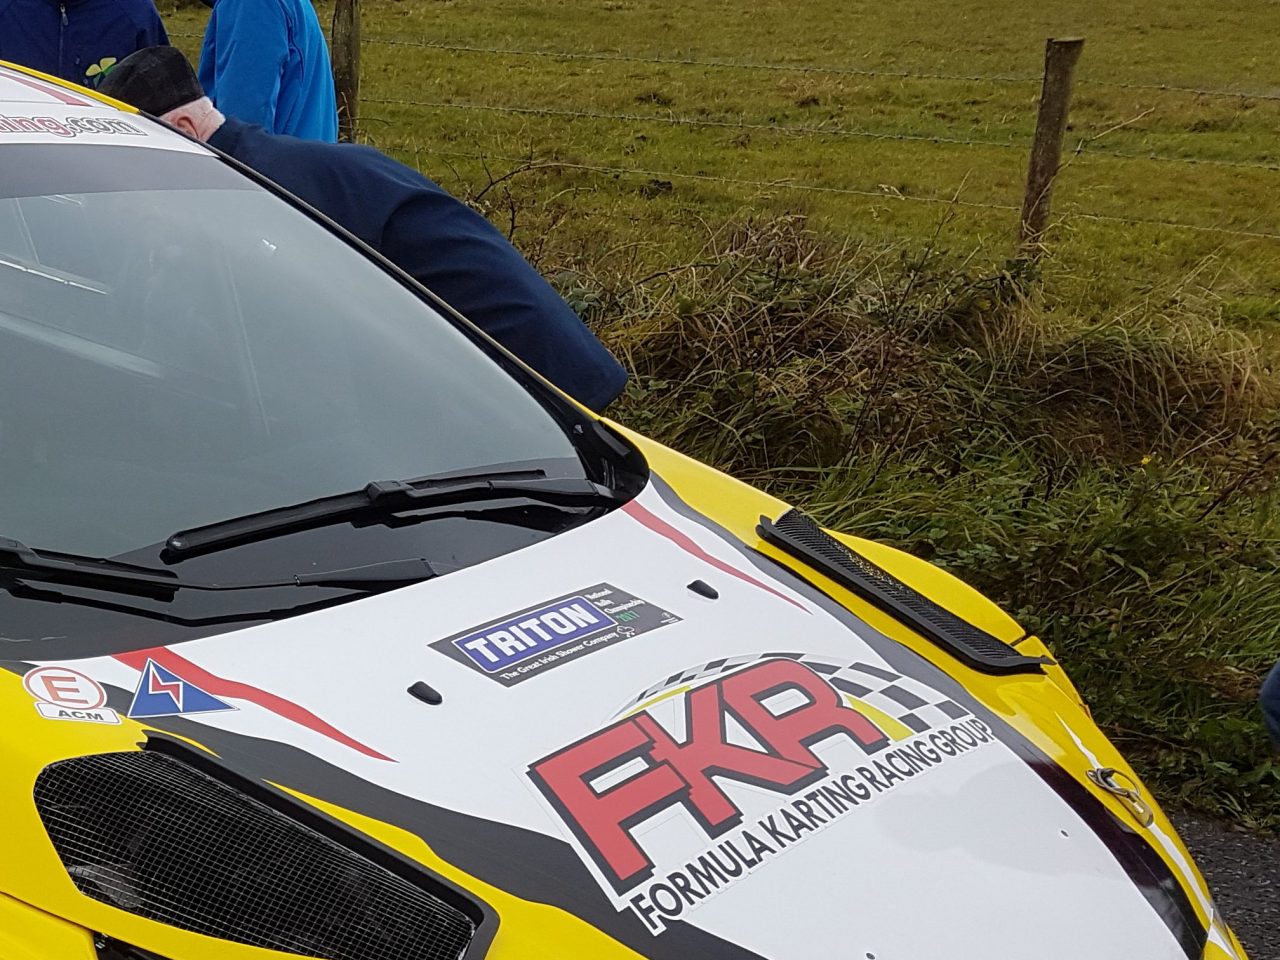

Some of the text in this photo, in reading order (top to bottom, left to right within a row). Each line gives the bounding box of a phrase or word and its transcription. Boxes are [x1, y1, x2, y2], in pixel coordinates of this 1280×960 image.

[464, 603, 600, 663] TRITON
[500, 671, 520, 681] The
[517, 661, 541, 674] Great
[556, 644, 585, 658] Shower
[582, 631, 620, 647] Company
[40, 675, 90, 705] E
[58, 709, 104, 721] ACM
[527, 656, 892, 898] FKR
[629, 717, 996, 932] FORMULA KARTING RACING GROUP
